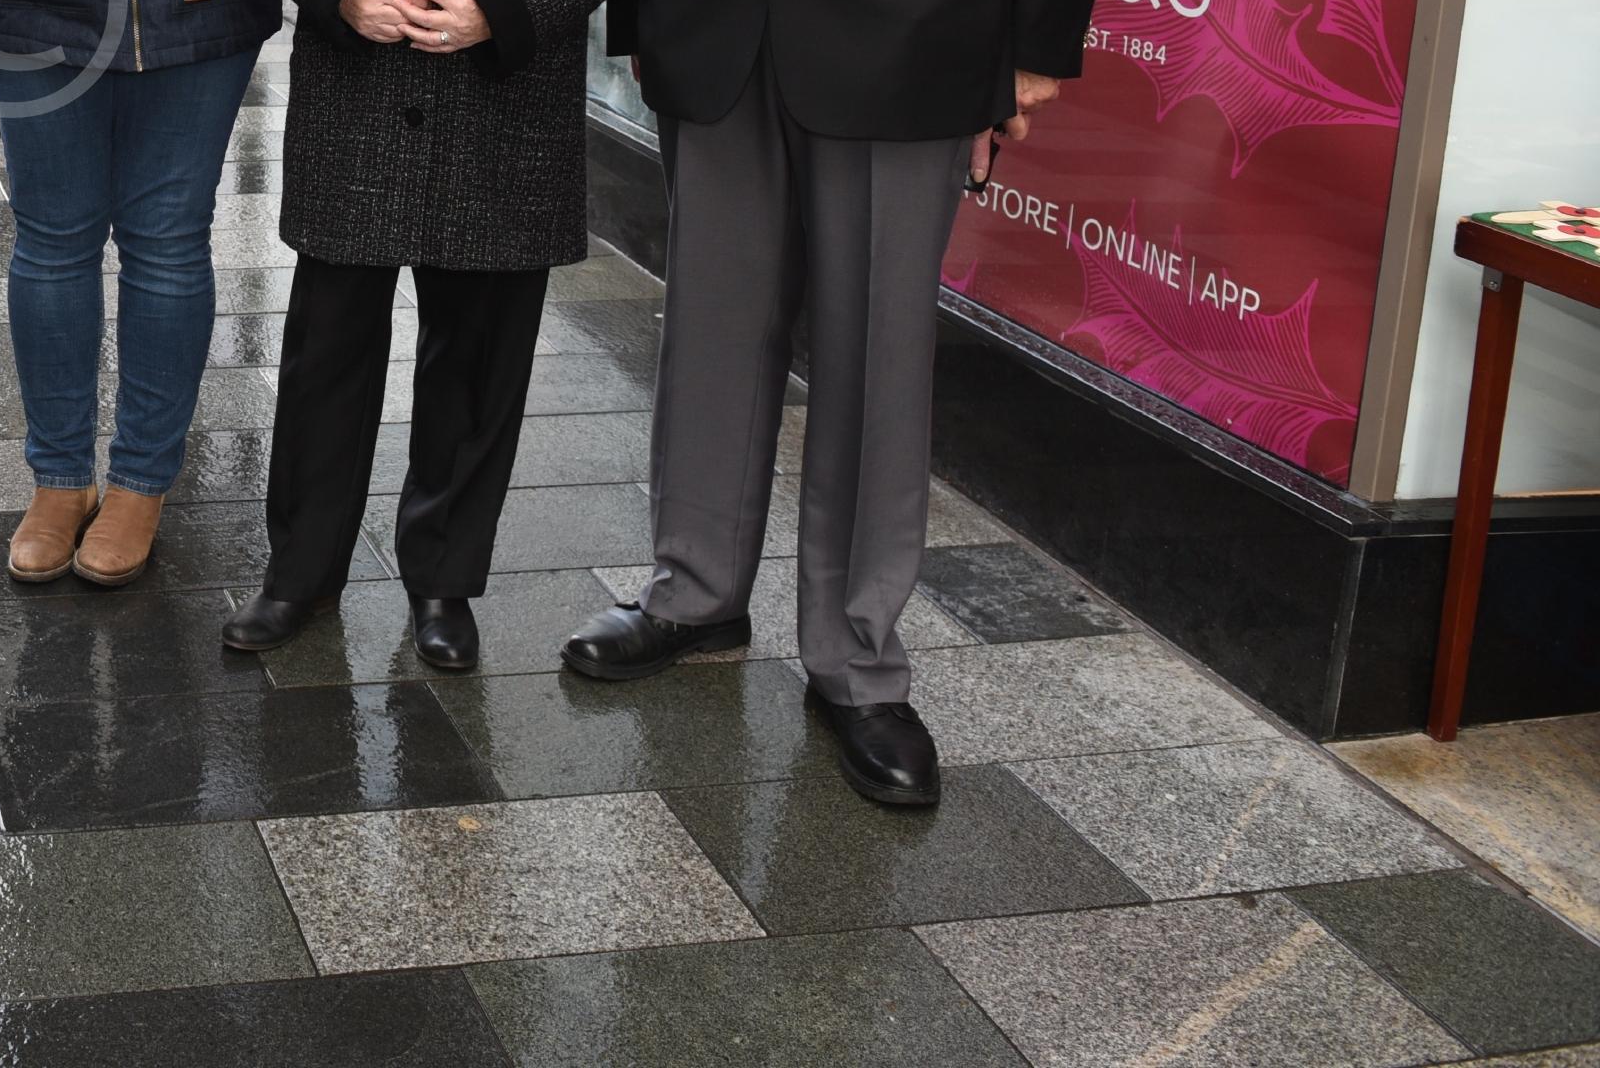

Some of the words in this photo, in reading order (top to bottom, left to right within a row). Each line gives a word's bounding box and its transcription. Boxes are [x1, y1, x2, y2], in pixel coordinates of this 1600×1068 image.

[1087, 27, 1116, 54] ST.
[1122, 35, 1167, 65] 1884
[975, 181, 1060, 236] STORE
[1081, 218, 1183, 290] ONLINE
[1200, 272, 1261, 321] APP
